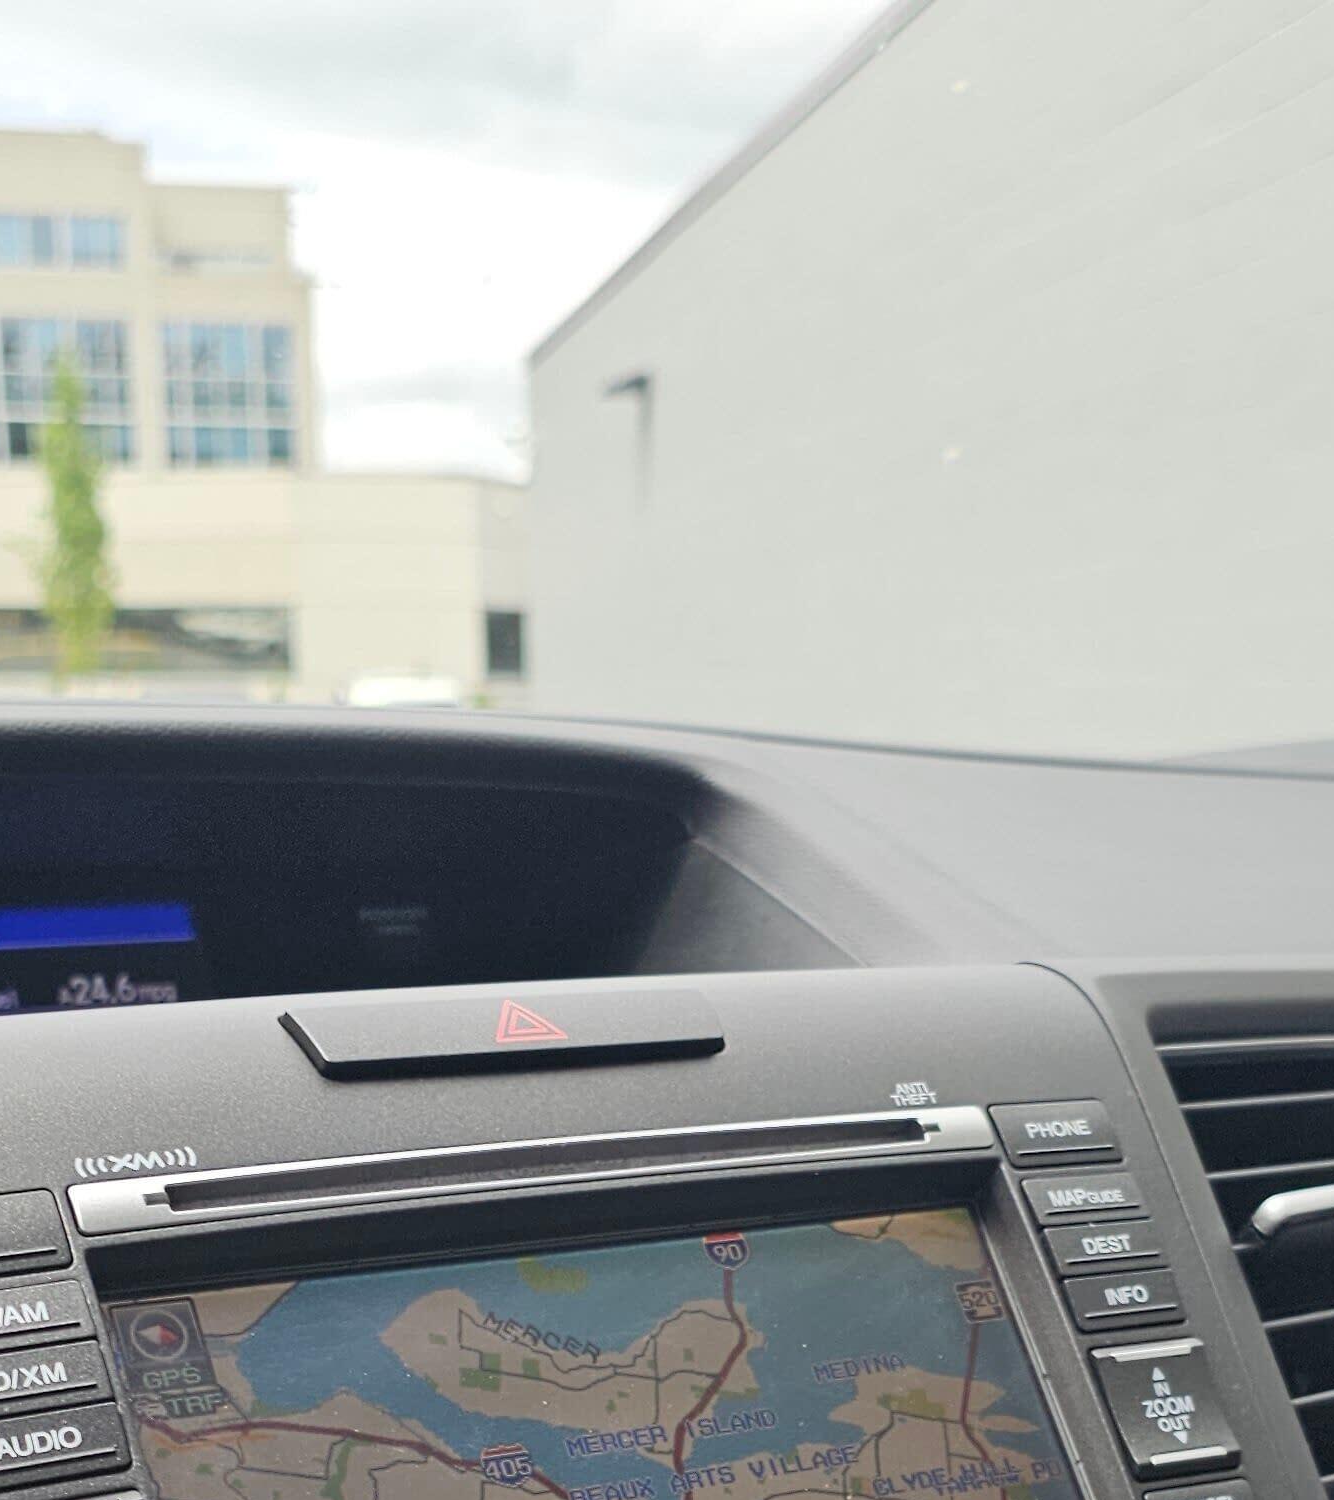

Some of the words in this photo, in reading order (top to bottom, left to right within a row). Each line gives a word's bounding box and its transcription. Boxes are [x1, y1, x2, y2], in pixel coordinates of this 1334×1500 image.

[890, 1093, 937, 1107] THEFT
[1025, 1120, 1091, 1138] PHONE
[712, 1243, 740, 1262] 90
[1081, 1235, 1131, 1255] DEST
[960, 1289, 997, 1309] 520
[1104, 1285, 1149, 1306] INFO
[142, 1364, 203, 1391] GPS
[812, 1353, 906, 1385] MEDINA
[1153, 1382, 1172, 1396] IN
[1141, 1395, 1196, 1419] ZOOM
[566, 1421, 668, 1458] MERCER
[683, 1409, 779, 1441] ISLAND
[1157, 1416, 1192, 1432] OUT
[485, 1457, 533, 1481] 405
[668, 1465, 736, 1495] ARTS
[747, 1444, 861, 1478] VILLAGE
[872, 1467, 947, 1497] CLYDE
